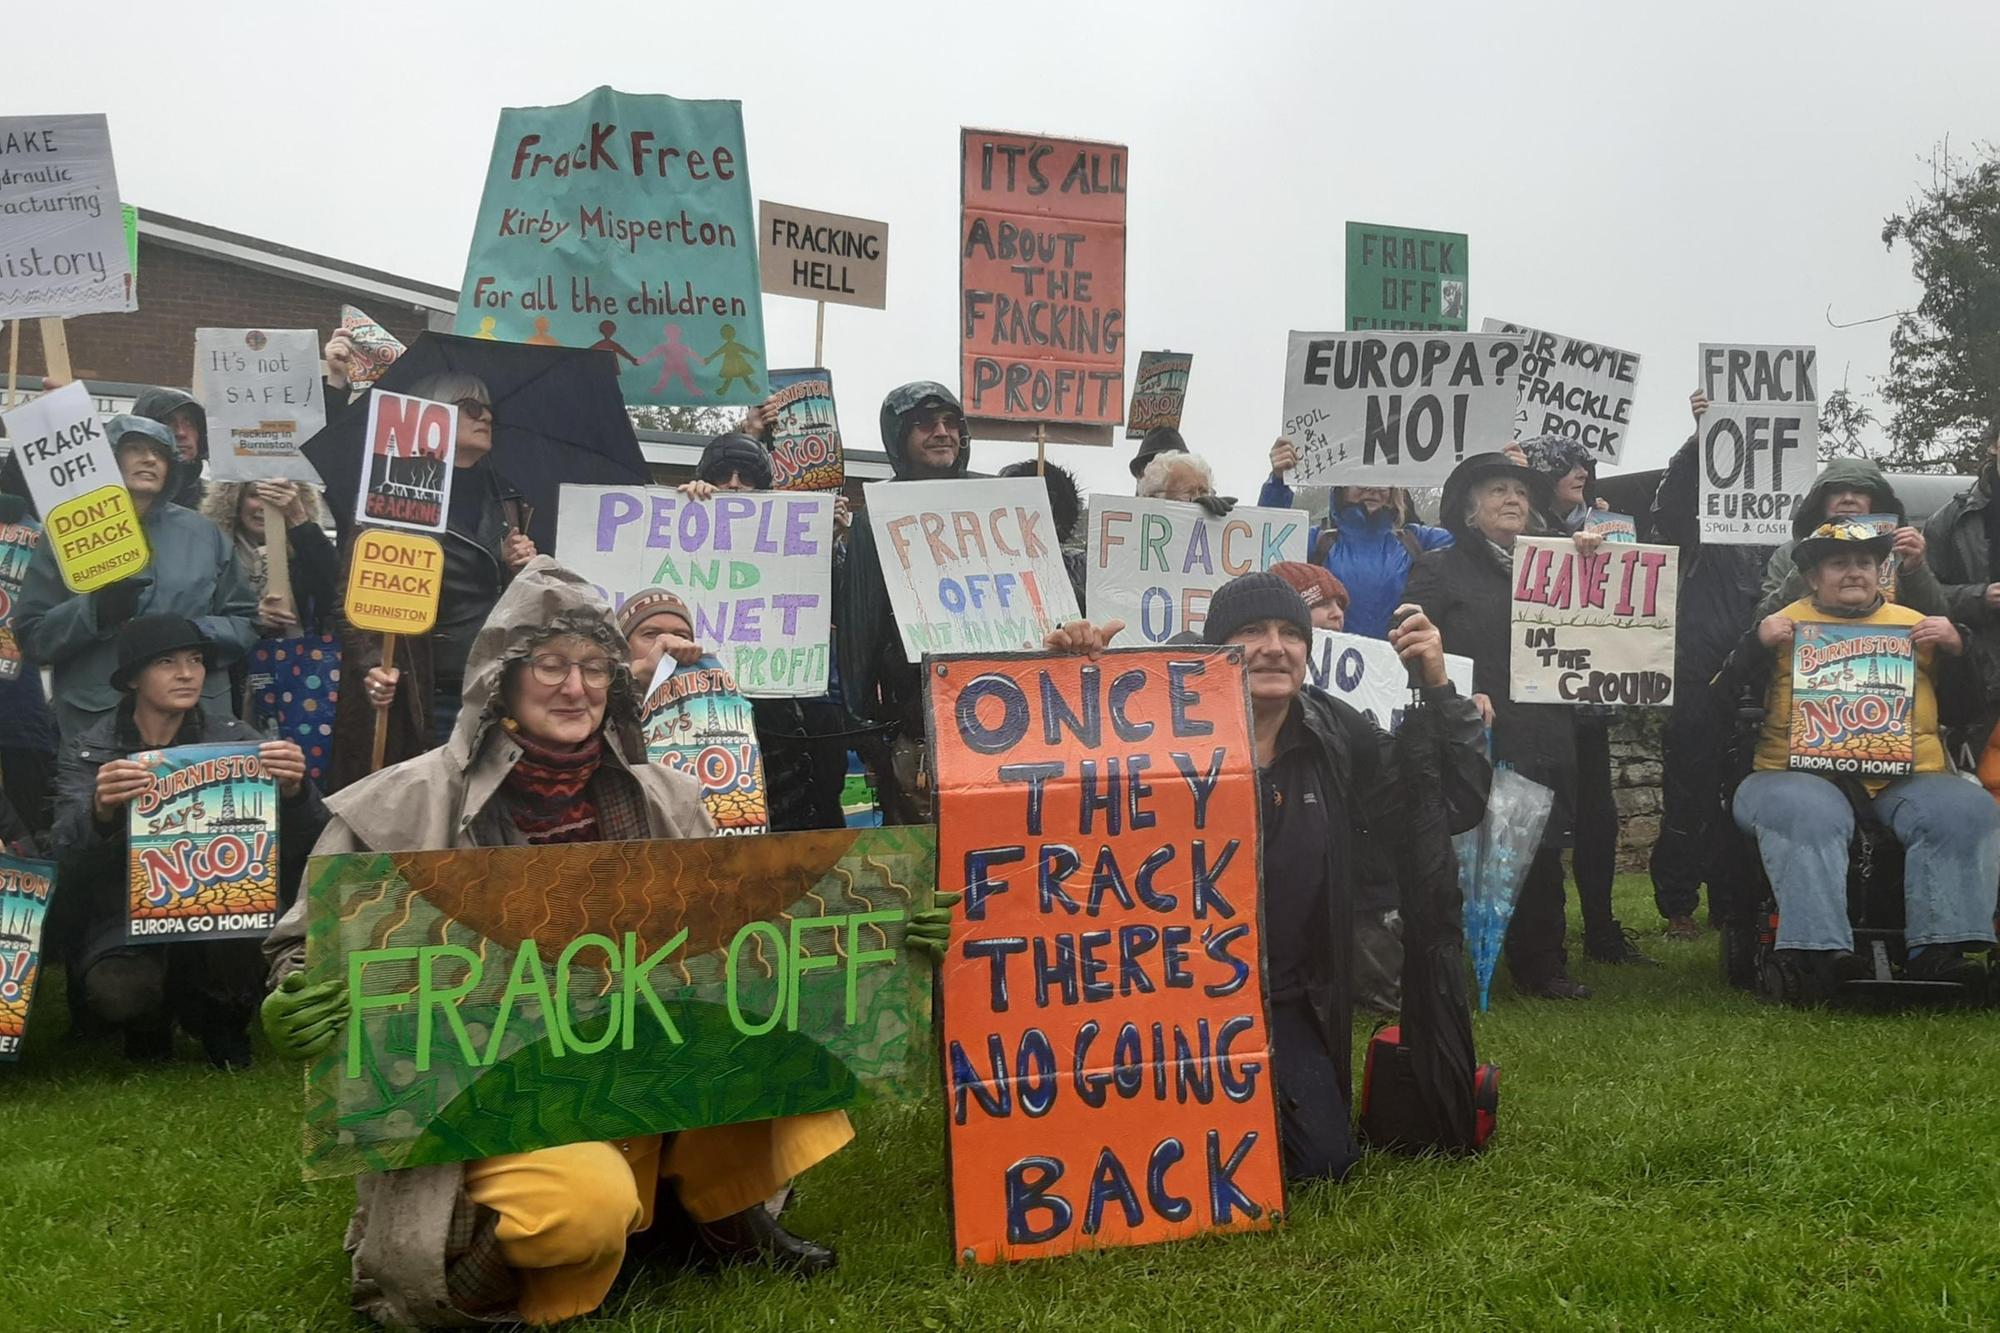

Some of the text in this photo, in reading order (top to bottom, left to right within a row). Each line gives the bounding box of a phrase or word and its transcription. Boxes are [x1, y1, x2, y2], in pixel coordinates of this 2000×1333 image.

[0, 130, 58, 154] AKE
[629, 131, 736, 182] Free
[0, 165, 73, 190] draulic
[981, 141, 1126, 196] IT'S ALL
[0, 192, 102, 218] acturing
[498, 204, 737, 254] Kirby Misperton
[771, 218, 881, 262] FRACKING
[964, 217, 1086, 269] ABOUT
[1361, 233, 1456, 275] FRACK
[472, 275, 747, 317] For all the children
[792, 259, 856, 295] HELL
[1010, 264, 1093, 303] THE
[1381, 277, 1436, 314] OFF
[964, 288, 1124, 354] FRACKING
[210, 350, 291, 374] It's not
[1302, 338, 1520, 390] EUROPA?
[1520, 352, 1557, 379] OT
[1560, 338, 1638, 384] HOME
[1704, 348, 1817, 403] FRACK
[972, 356, 1123, 417] PROFIT
[22, 416, 101, 466] FRACK
[373, 393, 452, 463] NO
[1285, 408, 1331, 436] SPOIL
[1362, 392, 1470, 466] NO!
[1540, 411, 1620, 457] ROCK
[1295, 433, 1329, 461] CASH
[1705, 416, 1802, 493] OFF
[49, 452, 97, 487] OFF!
[54, 493, 122, 535] DON'T
[366, 494, 442, 524] FRACKING
[595, 491, 820, 557] PEOPLE
[1704, 521, 1739, 534] SPOIL
[1757, 522, 1788, 535] CASH
[62, 518, 133, 560] FRACK
[362, 541, 438, 567] DON'T
[886, 506, 1049, 571] FRACK
[1099, 510, 1298, 577] FRACK
[71, 548, 141, 584] BURNISTON
[359, 569, 433, 596] FRACK
[650, 553, 761, 591] AND
[1513, 545, 1667, 618] LEAVE IT
[354, 601, 428, 622] BURNISTON
[938, 571, 1045, 622] OFF!
[1525, 627, 1556, 649] IN
[734, 642, 829, 687] PROFIT
[1536, 648, 1591, 672] THE
[1806, 668, 1855, 690] SAYS
[954, 660, 1215, 755] ONCE
[1557, 670, 1673, 705] GROUND
[1789, 754, 1912, 776] EUROPA GO HOME!
[998, 746, 1226, 836] THEY
[147, 800, 206, 836] SAYS
[963, 838, 1241, 920] FRACK
[130, 911, 276, 937] EUROPA GO HOME!
[962, 922, 1250, 1014] THERE'S
[346, 909, 905, 1080] FRACK OFF
[950, 1014, 1262, 1126] NO GOING
[1004, 1130, 1263, 1246] BACK
